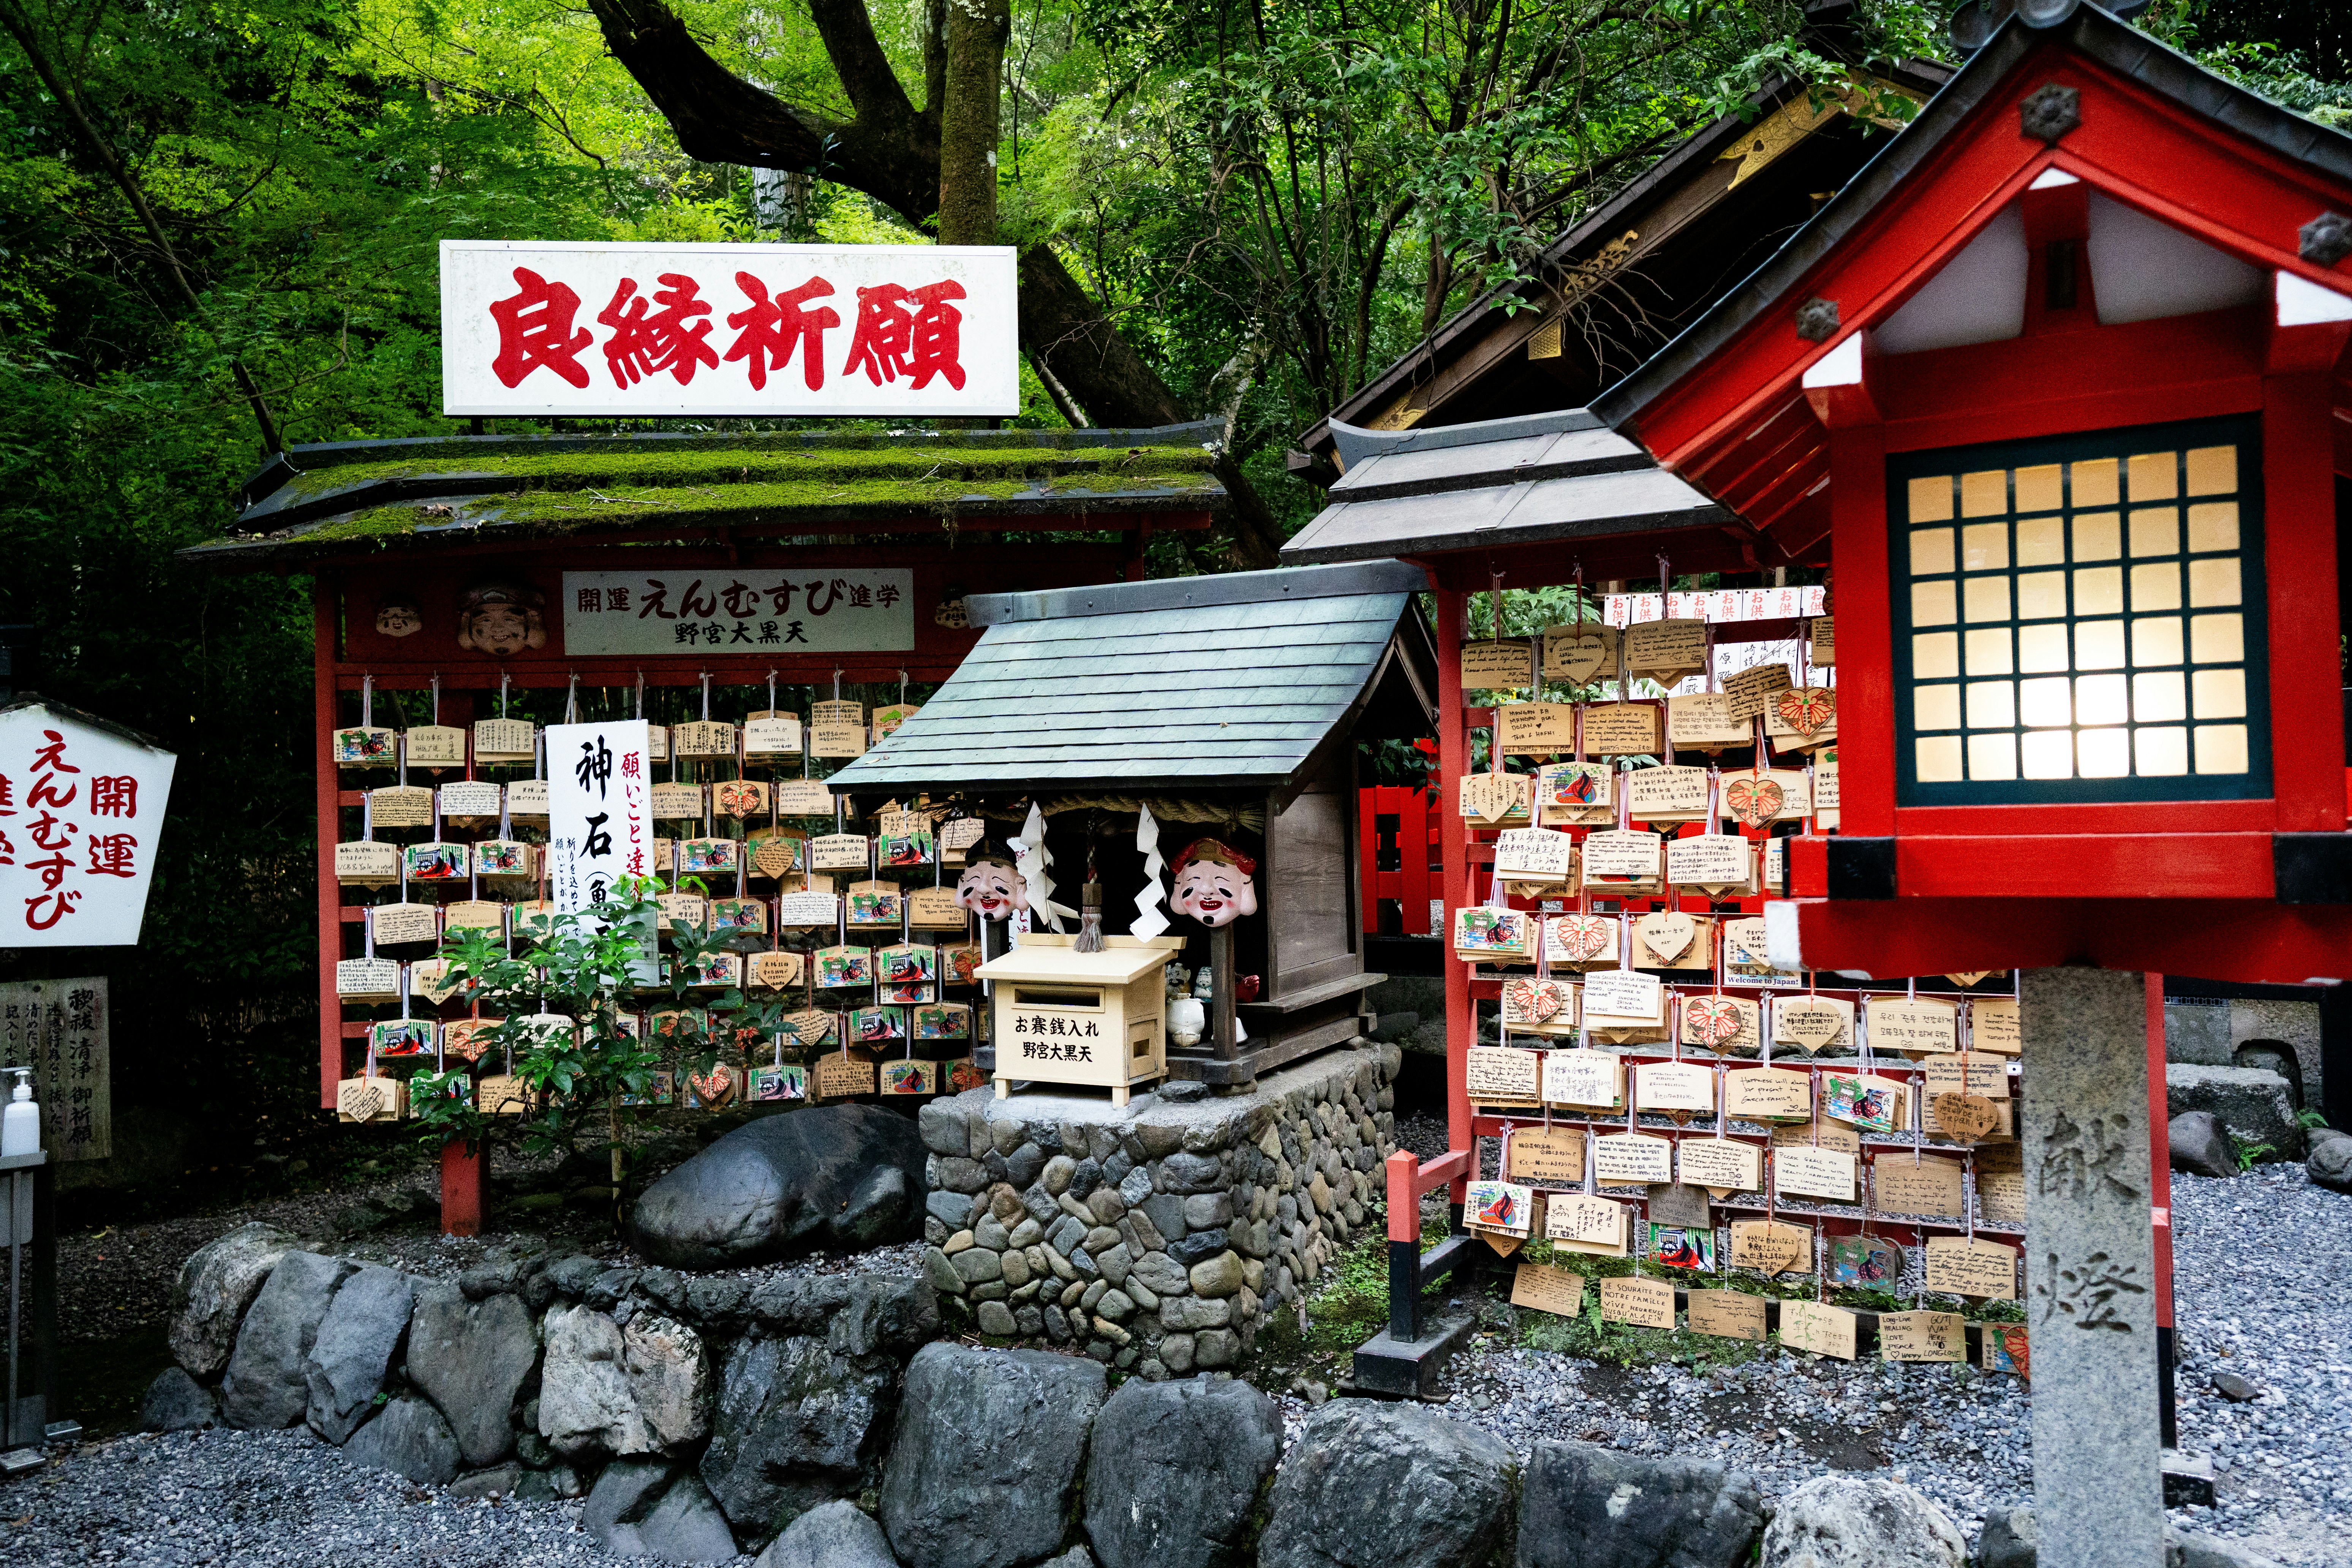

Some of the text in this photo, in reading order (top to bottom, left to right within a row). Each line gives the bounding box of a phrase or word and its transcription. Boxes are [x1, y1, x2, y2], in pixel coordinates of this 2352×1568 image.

[490, 266, 967, 391] 良縁祈願
[577, 578, 900, 620] 開運 えんむすび 進学
[675, 621, 809, 646] 野宮大黒天
[24, 729, 82, 930] えんむすび
[85, 775, 138, 878] 開運
[1513, 920, 1521, 940] 良縁
[1015, 1015, 1099, 1037] お賽銭入れ
[1922, 1016, 1952, 1024] 건강하게
[1023, 1041, 1093, 1062] 野宮大黒天
[1758, 1086, 1783, 1095] present
[1880, 1097, 1891, 1119] 良縁
[1630, 1306, 1664, 1316] HEUREUSE
[1926, 1340, 1945, 1349] AND
